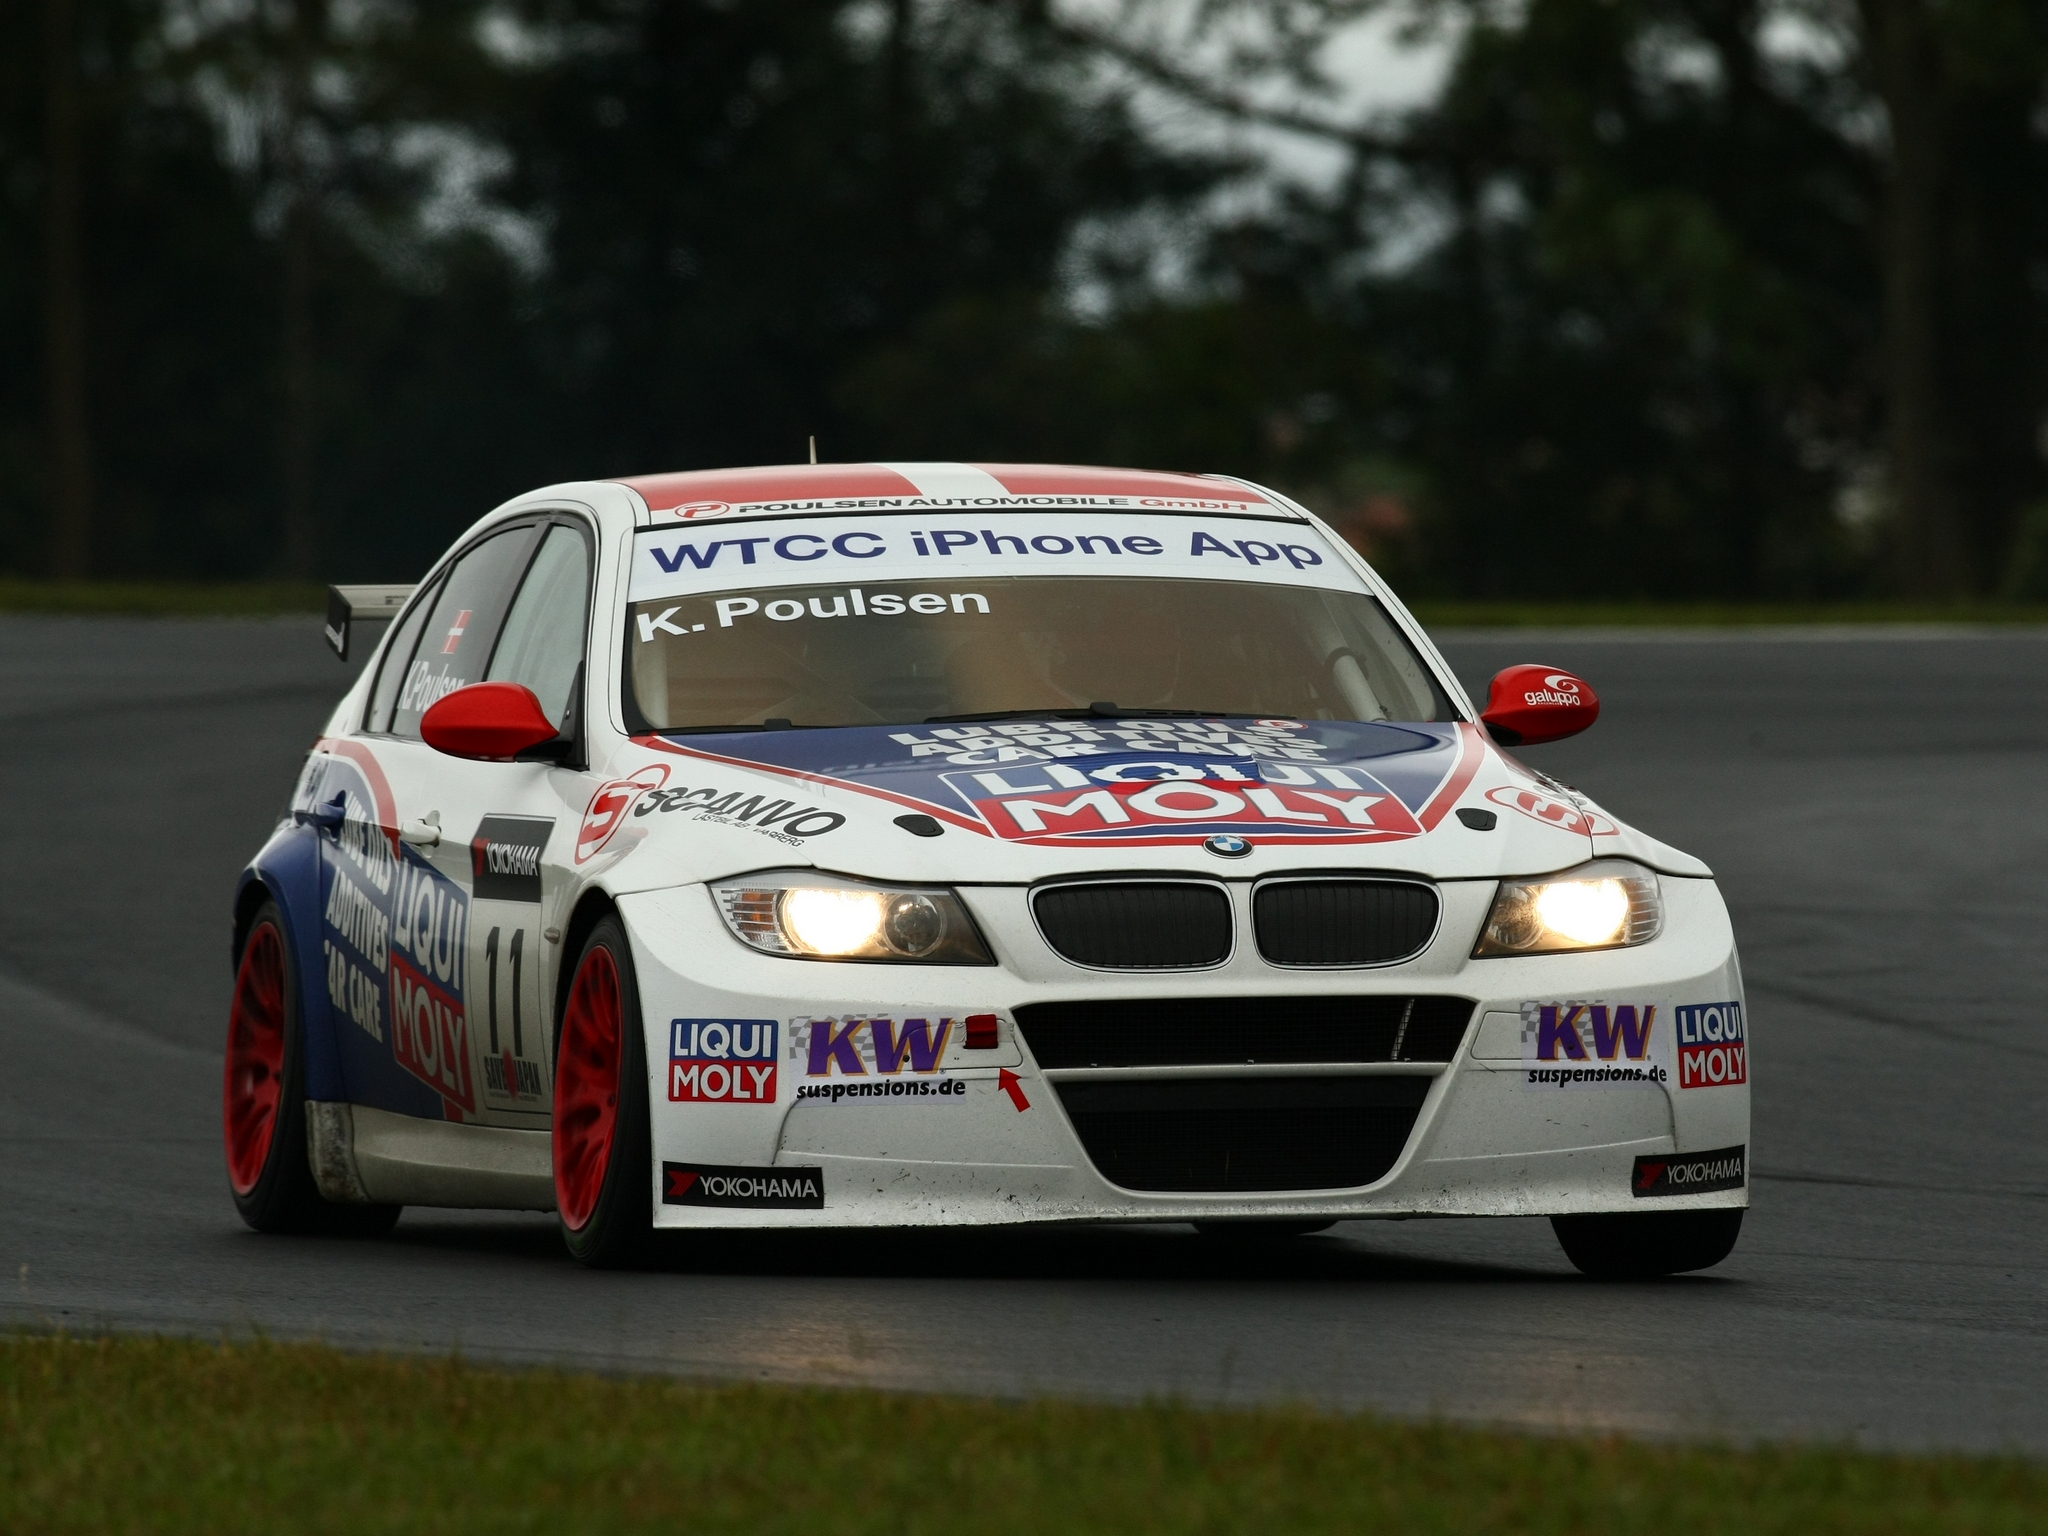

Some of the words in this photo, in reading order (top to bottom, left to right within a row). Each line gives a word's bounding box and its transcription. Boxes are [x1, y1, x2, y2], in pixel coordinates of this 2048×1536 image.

[739, 499, 901, 513] POULSEN
[908, 497, 1129, 507] AUTOMOBILE
[1140, 499, 1247, 511] GmbH
[649, 532, 887, 573] WTCC
[911, 529, 1164, 556] iPhone
[1190, 531, 1323, 570] App
[636, 606, 705, 643] K.
[715, 588, 991, 628] Poulsen
[1524, 688, 1581, 706] galuppo
[888, 721, 1097, 745] LUBE
[1116, 721, 1296, 738] OILS
[911, 729, 1328, 757] ADDITIVES
[946, 742, 1108, 765] CAR
[1126, 739, 1328, 762] CARE
[972, 762, 1363, 795] LIQUI
[1002, 780, 1386, 832] MOLY
[486, 842, 540, 876] YOKOHAMA
[325, 865, 388, 974] ADDITIVES
[395, 856, 464, 991] LIQUI
[350, 963, 383, 1043] CARE
[486, 926, 524, 1057] 11
[394, 965, 466, 1097] MOLY
[674, 1022, 772, 1059] LIQUI
[1536, 1004, 1657, 1062] KW
[1680, 1005, 1743, 1044] LIQUI
[805, 1016, 956, 1077] KW
[484, 1056, 509, 1090] SAVE
[672, 1063, 775, 1100] MOLY
[1528, 1064, 1667, 1088] suspensions.de
[1683, 1047, 1744, 1085] MOLY
[796, 1077, 966, 1103] suspensions.de
[699, 1175, 818, 1198] YOKOHAMA
[1667, 1157, 1742, 1184] YOKOHAMA
